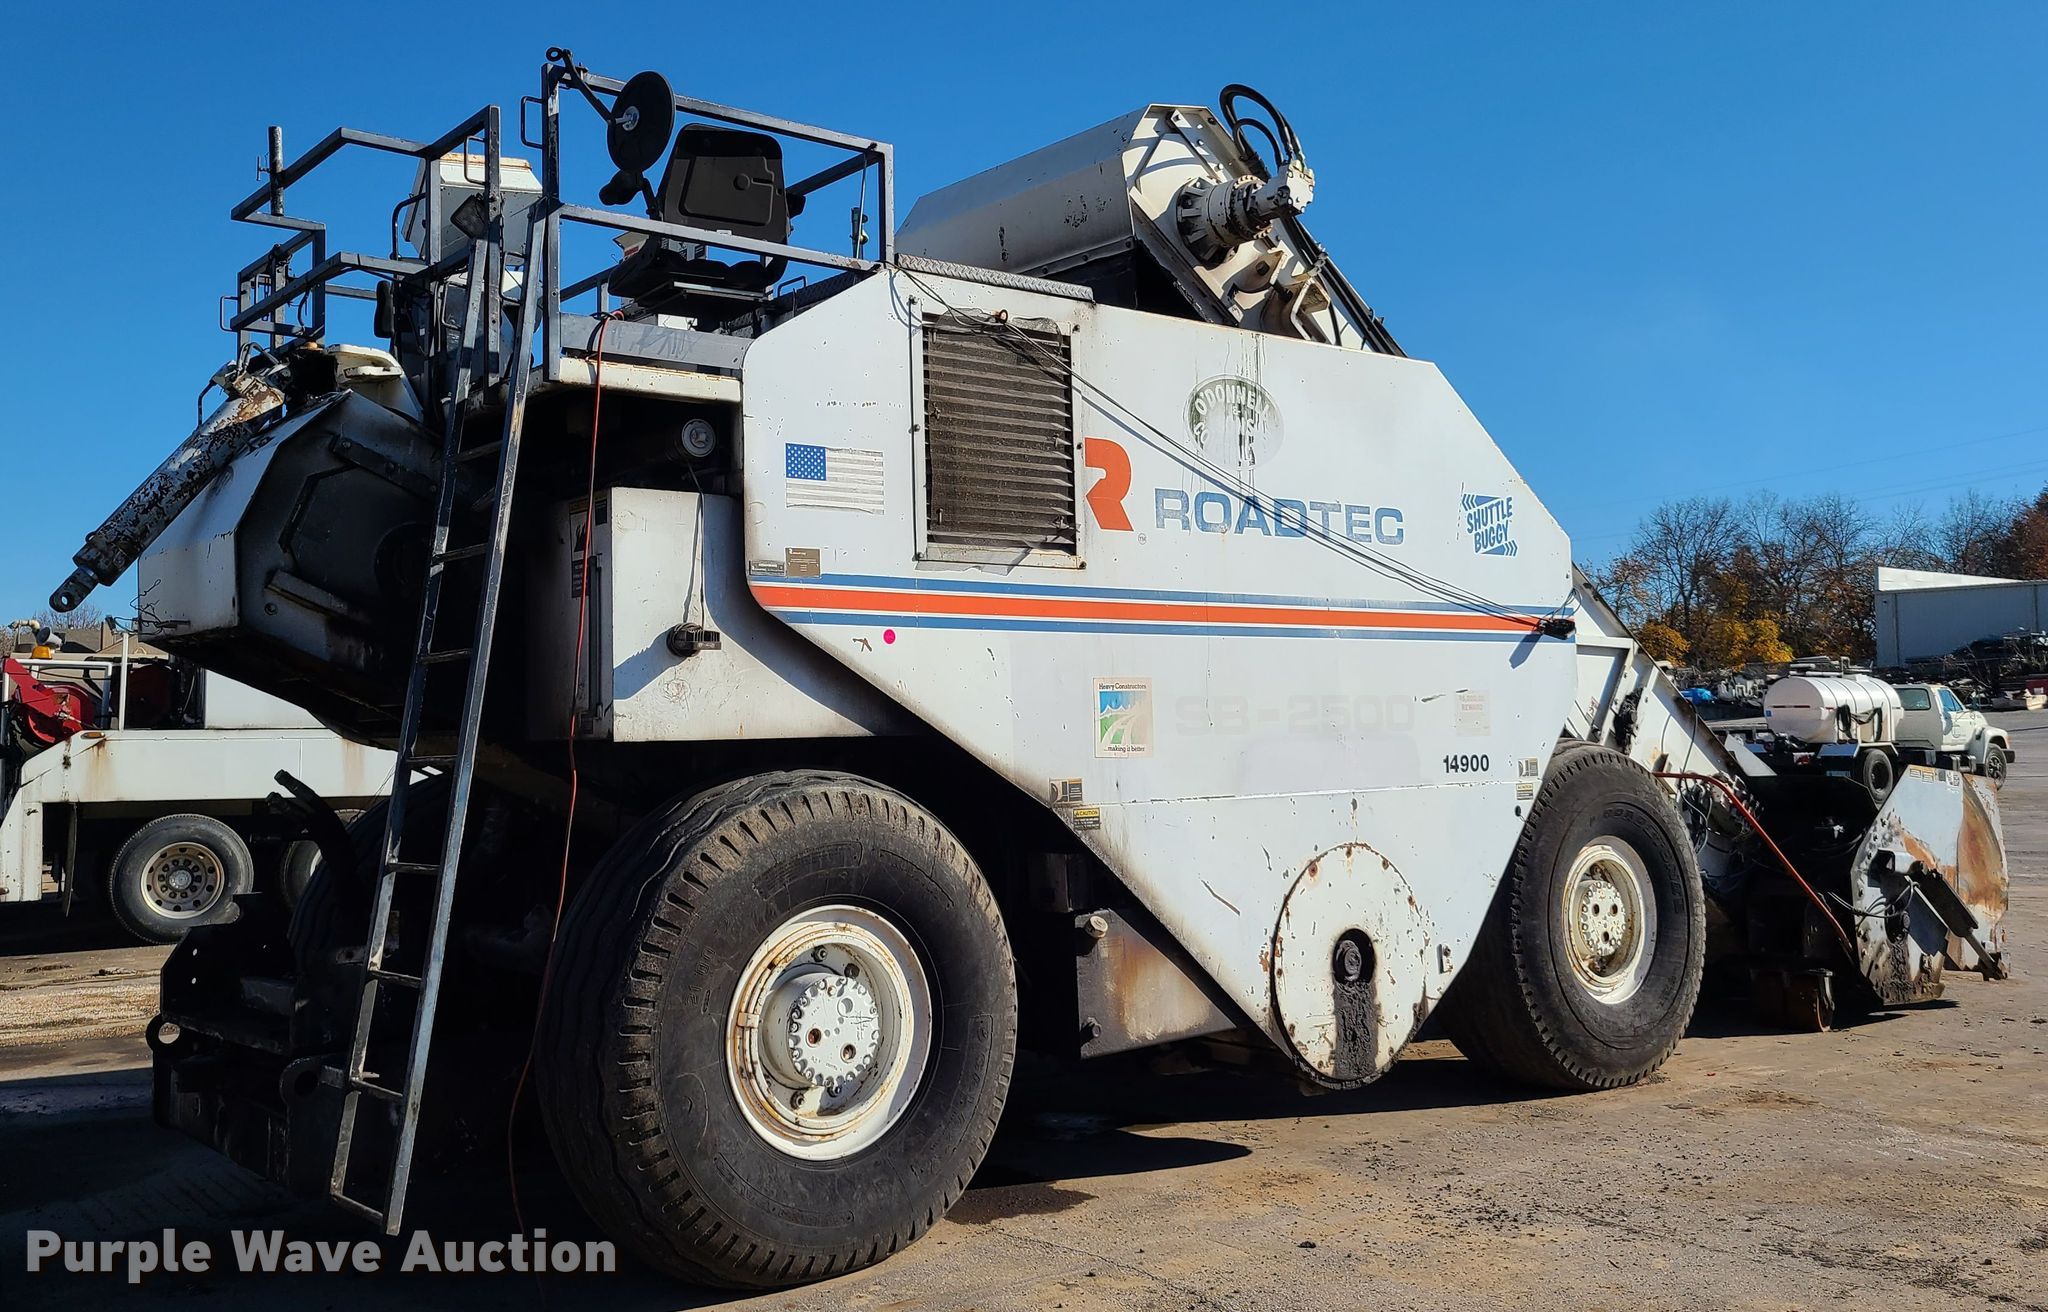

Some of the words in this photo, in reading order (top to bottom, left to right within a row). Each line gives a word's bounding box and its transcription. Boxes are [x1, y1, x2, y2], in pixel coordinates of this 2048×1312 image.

[1154, 487, 1405, 546] ROADTEC
[1466, 496, 1513, 534] SHUTTLE
[1474, 519, 1509, 553] BUGGY
[1443, 754, 1490, 773] 14900
